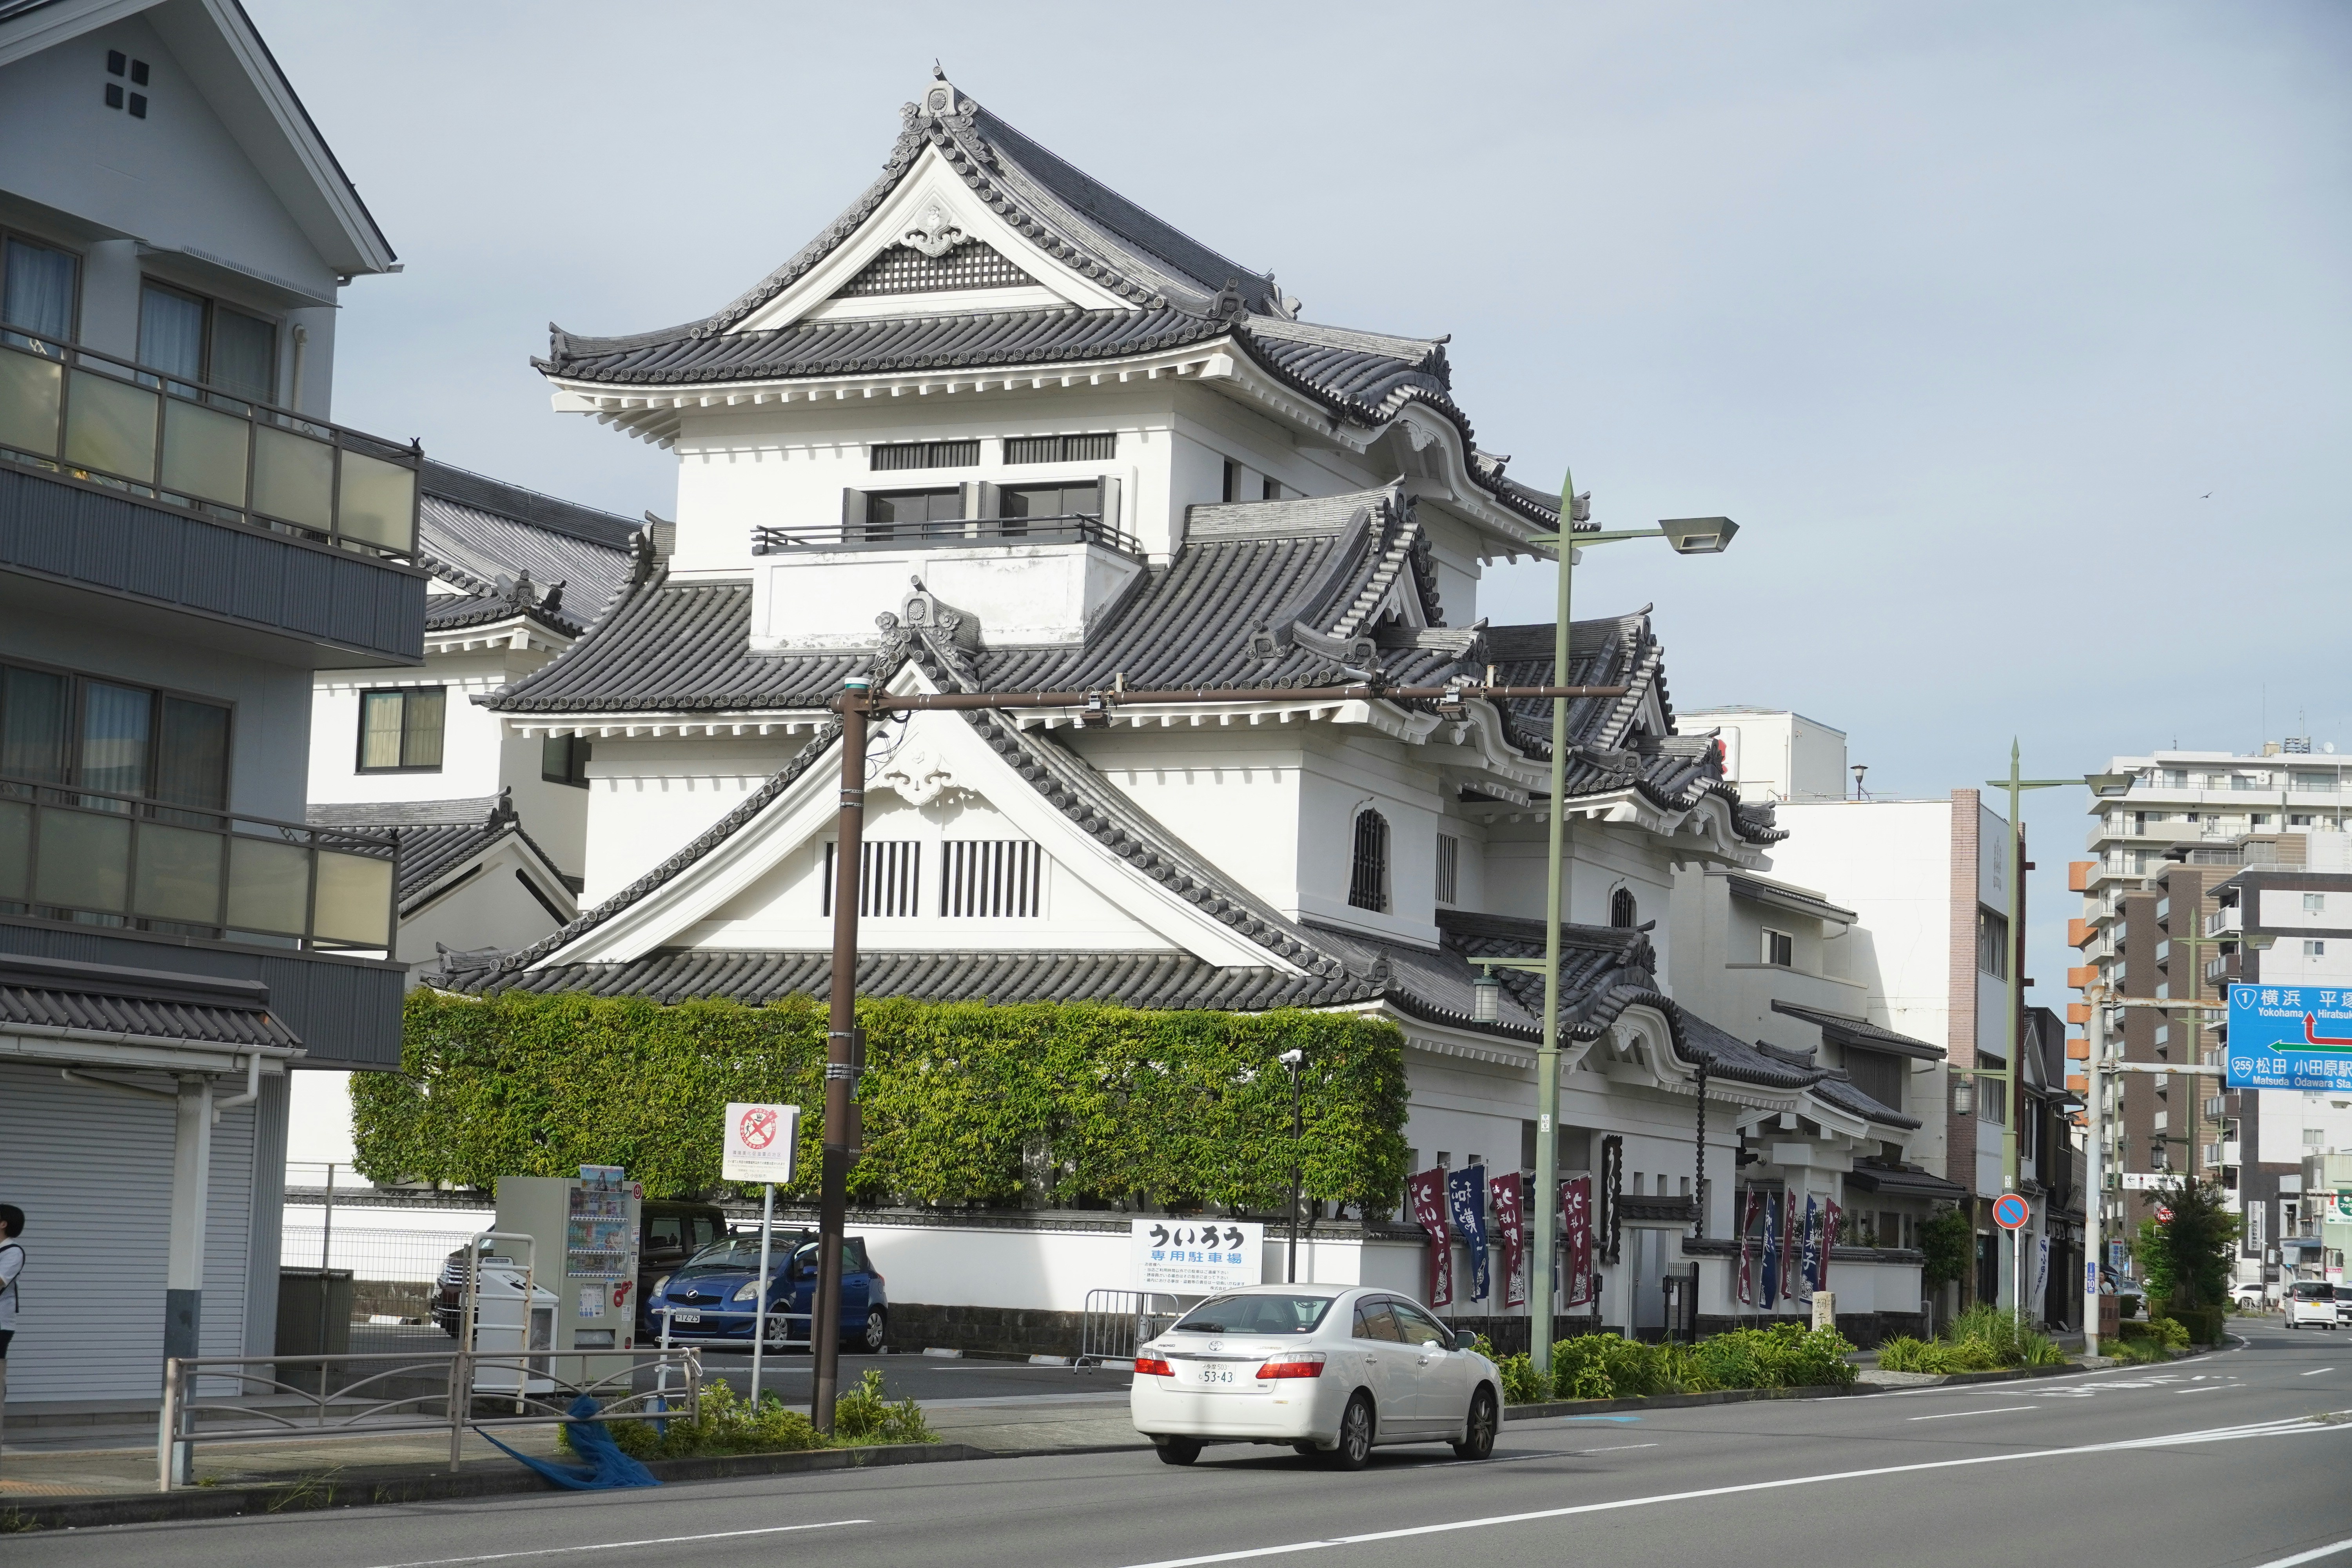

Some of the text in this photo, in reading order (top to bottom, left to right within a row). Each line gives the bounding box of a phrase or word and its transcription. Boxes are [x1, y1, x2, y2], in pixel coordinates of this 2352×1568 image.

[2241, 992, 2247, 1004] 1
[2261, 989, 2301, 1007] 横浜
[2258, 1007, 2303, 1018] Yokohama
[2235, 1060, 2251, 1070] 255
[2256, 1057, 2352, 1078] 松田 小田原駅
[2253, 1075, 2352, 1089] Matsuda Odawara Sta.
[1149, 1223, 1244, 1250] ういろう
[1151, 1250, 1242, 1264] 専用駐車場
[1204, 1371, 1233, 1383] 53-43
